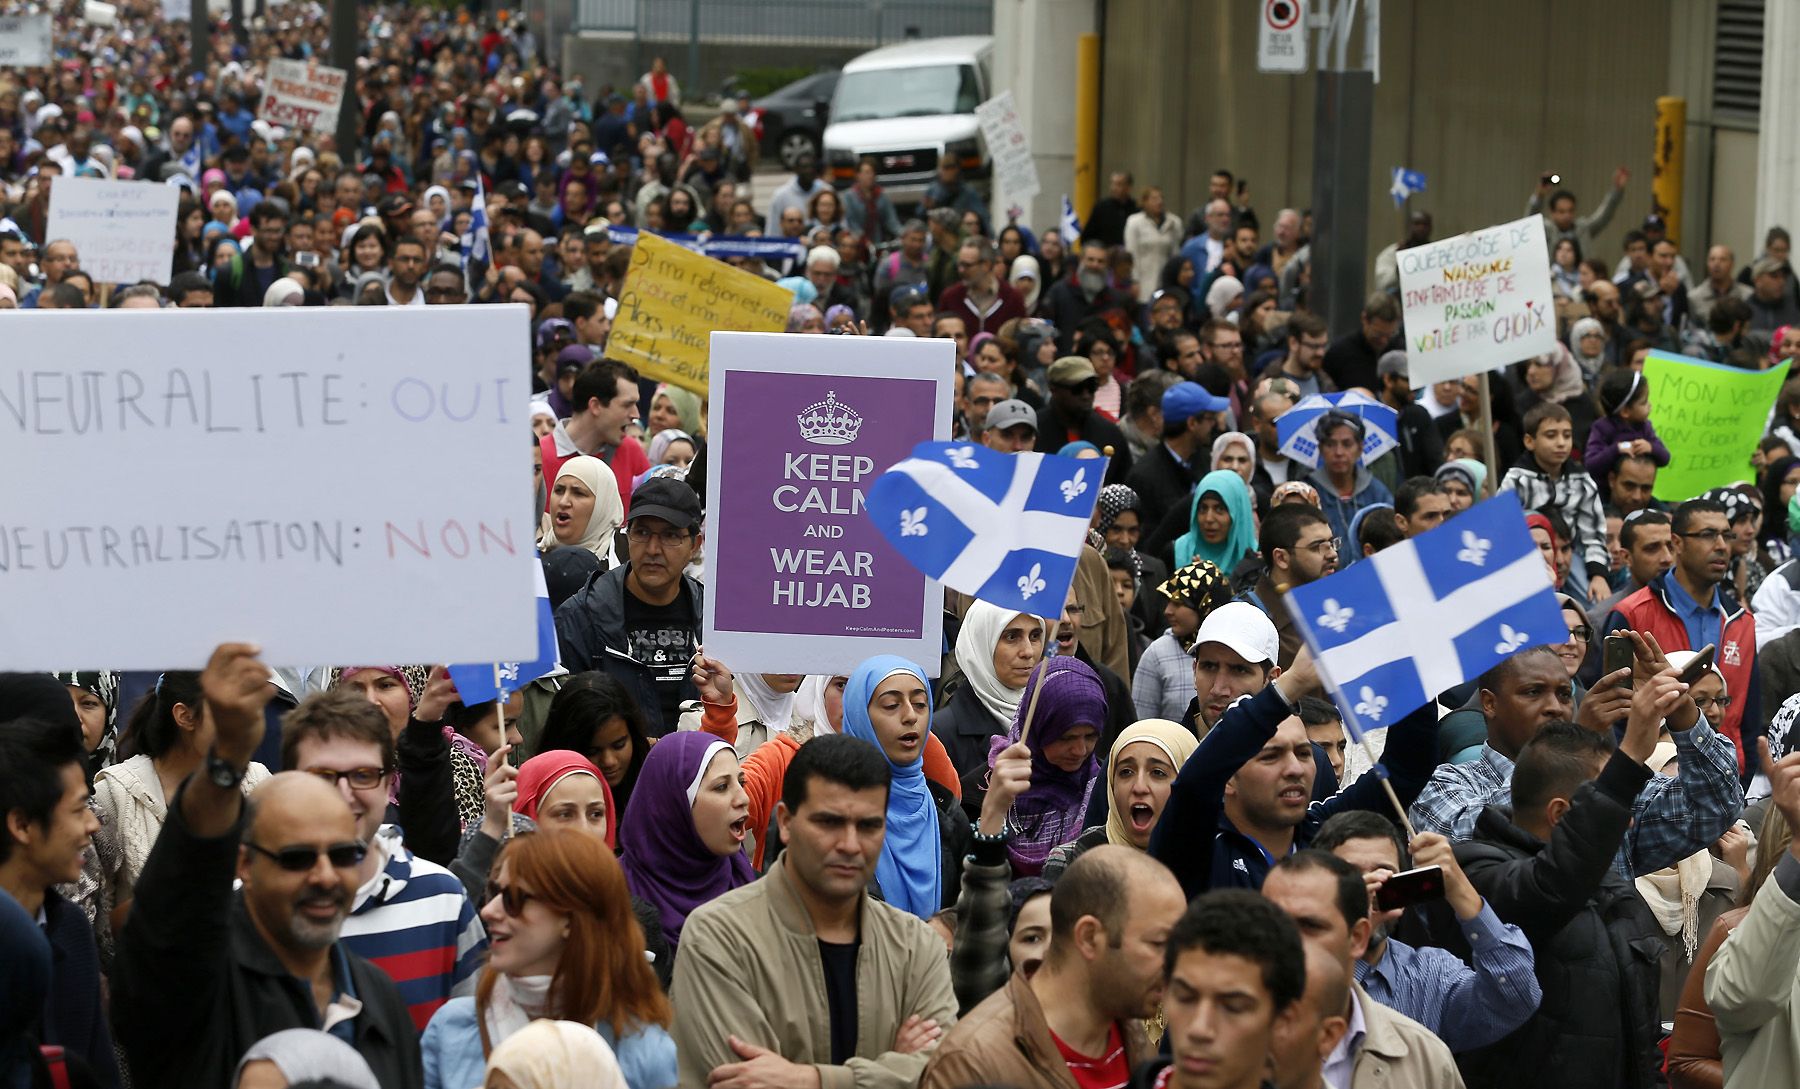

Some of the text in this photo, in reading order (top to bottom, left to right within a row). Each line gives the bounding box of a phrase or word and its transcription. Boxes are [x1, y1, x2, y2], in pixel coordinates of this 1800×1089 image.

[1510, 223, 1532, 249] DE
[1497, 273, 1517, 294] DE
[391, 376, 510, 424] OUI
[1660, 372, 1719, 405] MON
[784, 452, 874, 483] KEEP
[384, 518, 516, 560] NON
[803, 524, 844, 539] AND
[770, 547, 874, 577] WEAR
[772, 580, 872, 609] HIJAB
